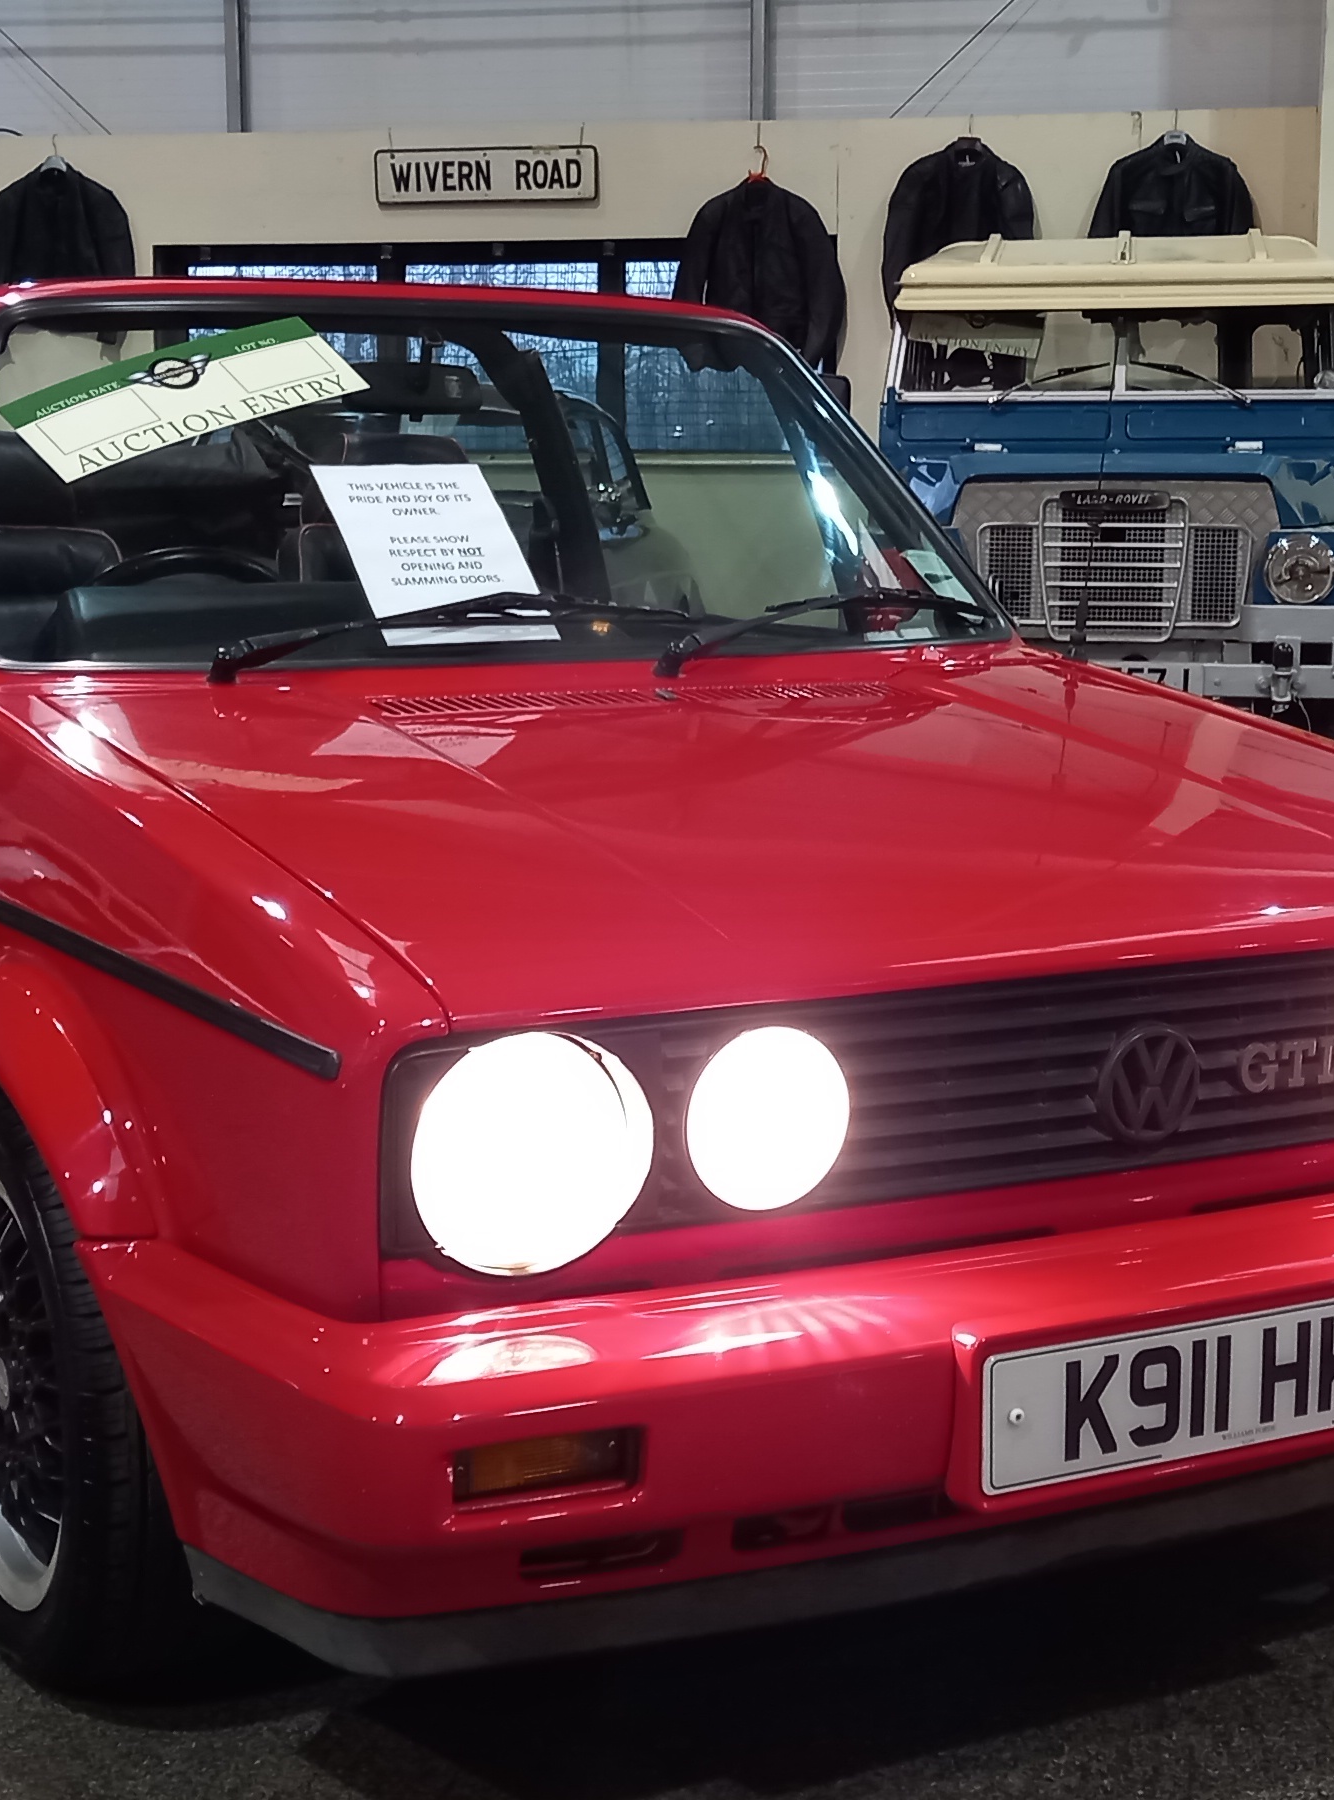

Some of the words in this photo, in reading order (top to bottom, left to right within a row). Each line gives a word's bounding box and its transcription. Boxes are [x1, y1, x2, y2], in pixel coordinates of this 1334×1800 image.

[389, 159, 492, 193] WIVERN
[514, 158, 583, 191] ROAD
[234, 342, 257, 353] LOT
[260, 336, 280, 347] NO.
[35, 392, 89, 418] AUCTION
[88, 380, 121, 397] DATE
[75, 403, 238, 474] AUCTION
[238, 373, 350, 417] ENTRY
[347, 482, 375, 492] THIS
[375, 481, 421, 491] VEHICLE
[425, 481, 436, 491] IS
[437, 481, 460, 491] THE
[348, 494, 383, 504] PRIDE
[385, 494, 411, 504] AND
[414, 493, 435, 504] JOY
[435, 493, 453, 503] OF
[453, 493, 472, 503] ITS
[391, 506, 441, 516] OWNER.
[389, 535, 432, 545] PLEASE
[432, 534, 470, 544] SHOW
[388, 548, 438, 558] RESPECT
[441, 548, 457, 557] BY
[458, 546, 485, 557] NOT
[400, 561, 456, 571] OPENING
[457, 560, 483, 570] AND
[390, 575, 458, 586] SLAMMING
[459, 574, 505, 585] DOORS.
[1064, 1334, 1233, 1463] K911
